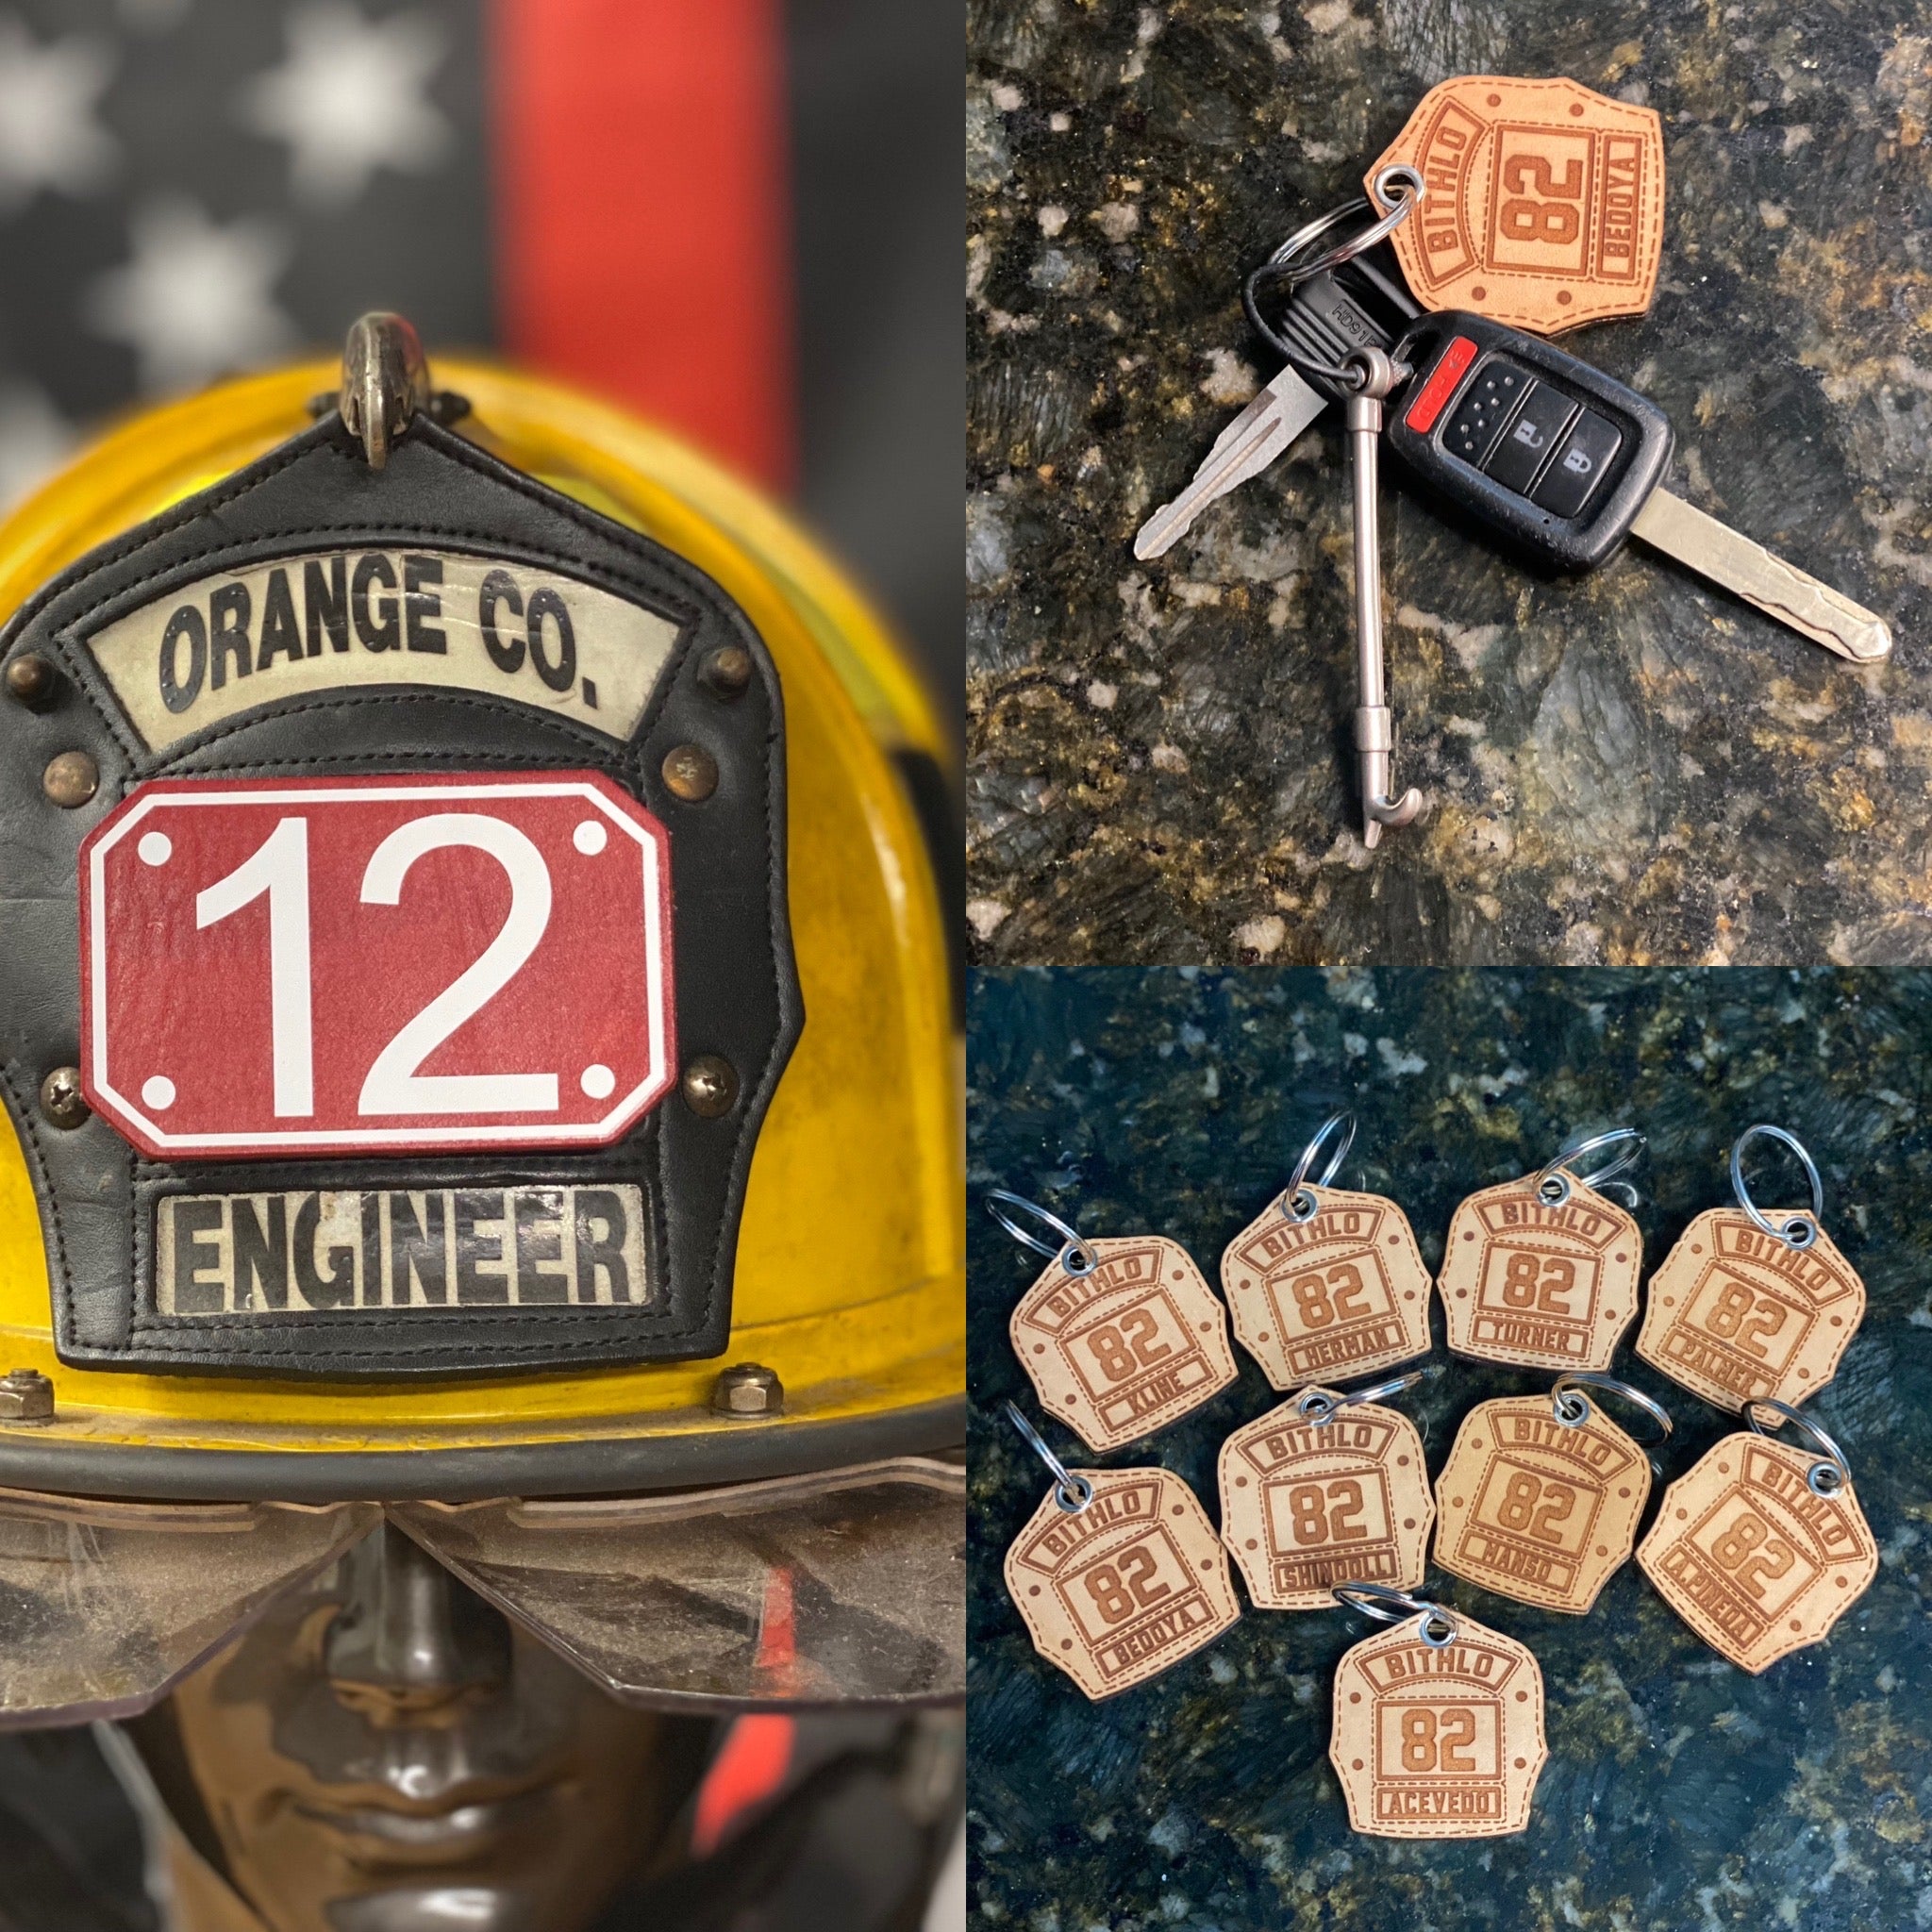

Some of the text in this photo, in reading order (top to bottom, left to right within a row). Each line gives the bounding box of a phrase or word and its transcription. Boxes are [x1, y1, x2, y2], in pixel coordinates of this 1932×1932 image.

[1424, 125, 1467, 253] BITHLO
[1500, 154, 1584, 244] 82
[1604, 156, 1636, 258] BEDOYA
[158, 555, 601, 715] ORANGE CO.
[195, 812, 560, 1118] 12
[172, 1186, 629, 1313] ENGINEER
[1261, 1213, 1359, 1258] BITHLO
[1501, 1202, 1601, 1236] BITHLO
[1047, 1257, 1142, 1317] BITHLO
[1503, 1253, 1575, 1314] 82
[1736, 1230, 1830, 1291] BITHLO
[1292, 1263, 1372, 1329] 82
[1705, 1282, 1787, 1358] 82
[1087, 1308, 1172, 1381] 82
[1305, 1328, 1390, 1366] HERMAN
[1492, 1322, 1570, 1351] TURNER
[1678, 1341, 1757, 1394] PALMER
[1126, 1372, 1185, 1414] KLINE
[1265, 1424, 1372, 1460] BITHLO
[1514, 1418, 1611, 1466] BITHLO
[1041, 1491, 1141, 1557] BITHLO
[1290, 1479, 1367, 1545] 82
[1497, 1471, 1576, 1544] 82
[1761, 1460, 1847, 1546] BITHLO
[1085, 1546, 1171, 1624] 82
[1482, 1541, 1552, 1582] MANSO
[1710, 1512, 1795, 1600] 82
[1113, 1610, 1195, 1665] BEDOYA
[1384, 1647, 1494, 1679] BITHLO
[1401, 1707, 1476, 1772] 82
[1388, 1792, 1491, 1814] ACEVEDO
